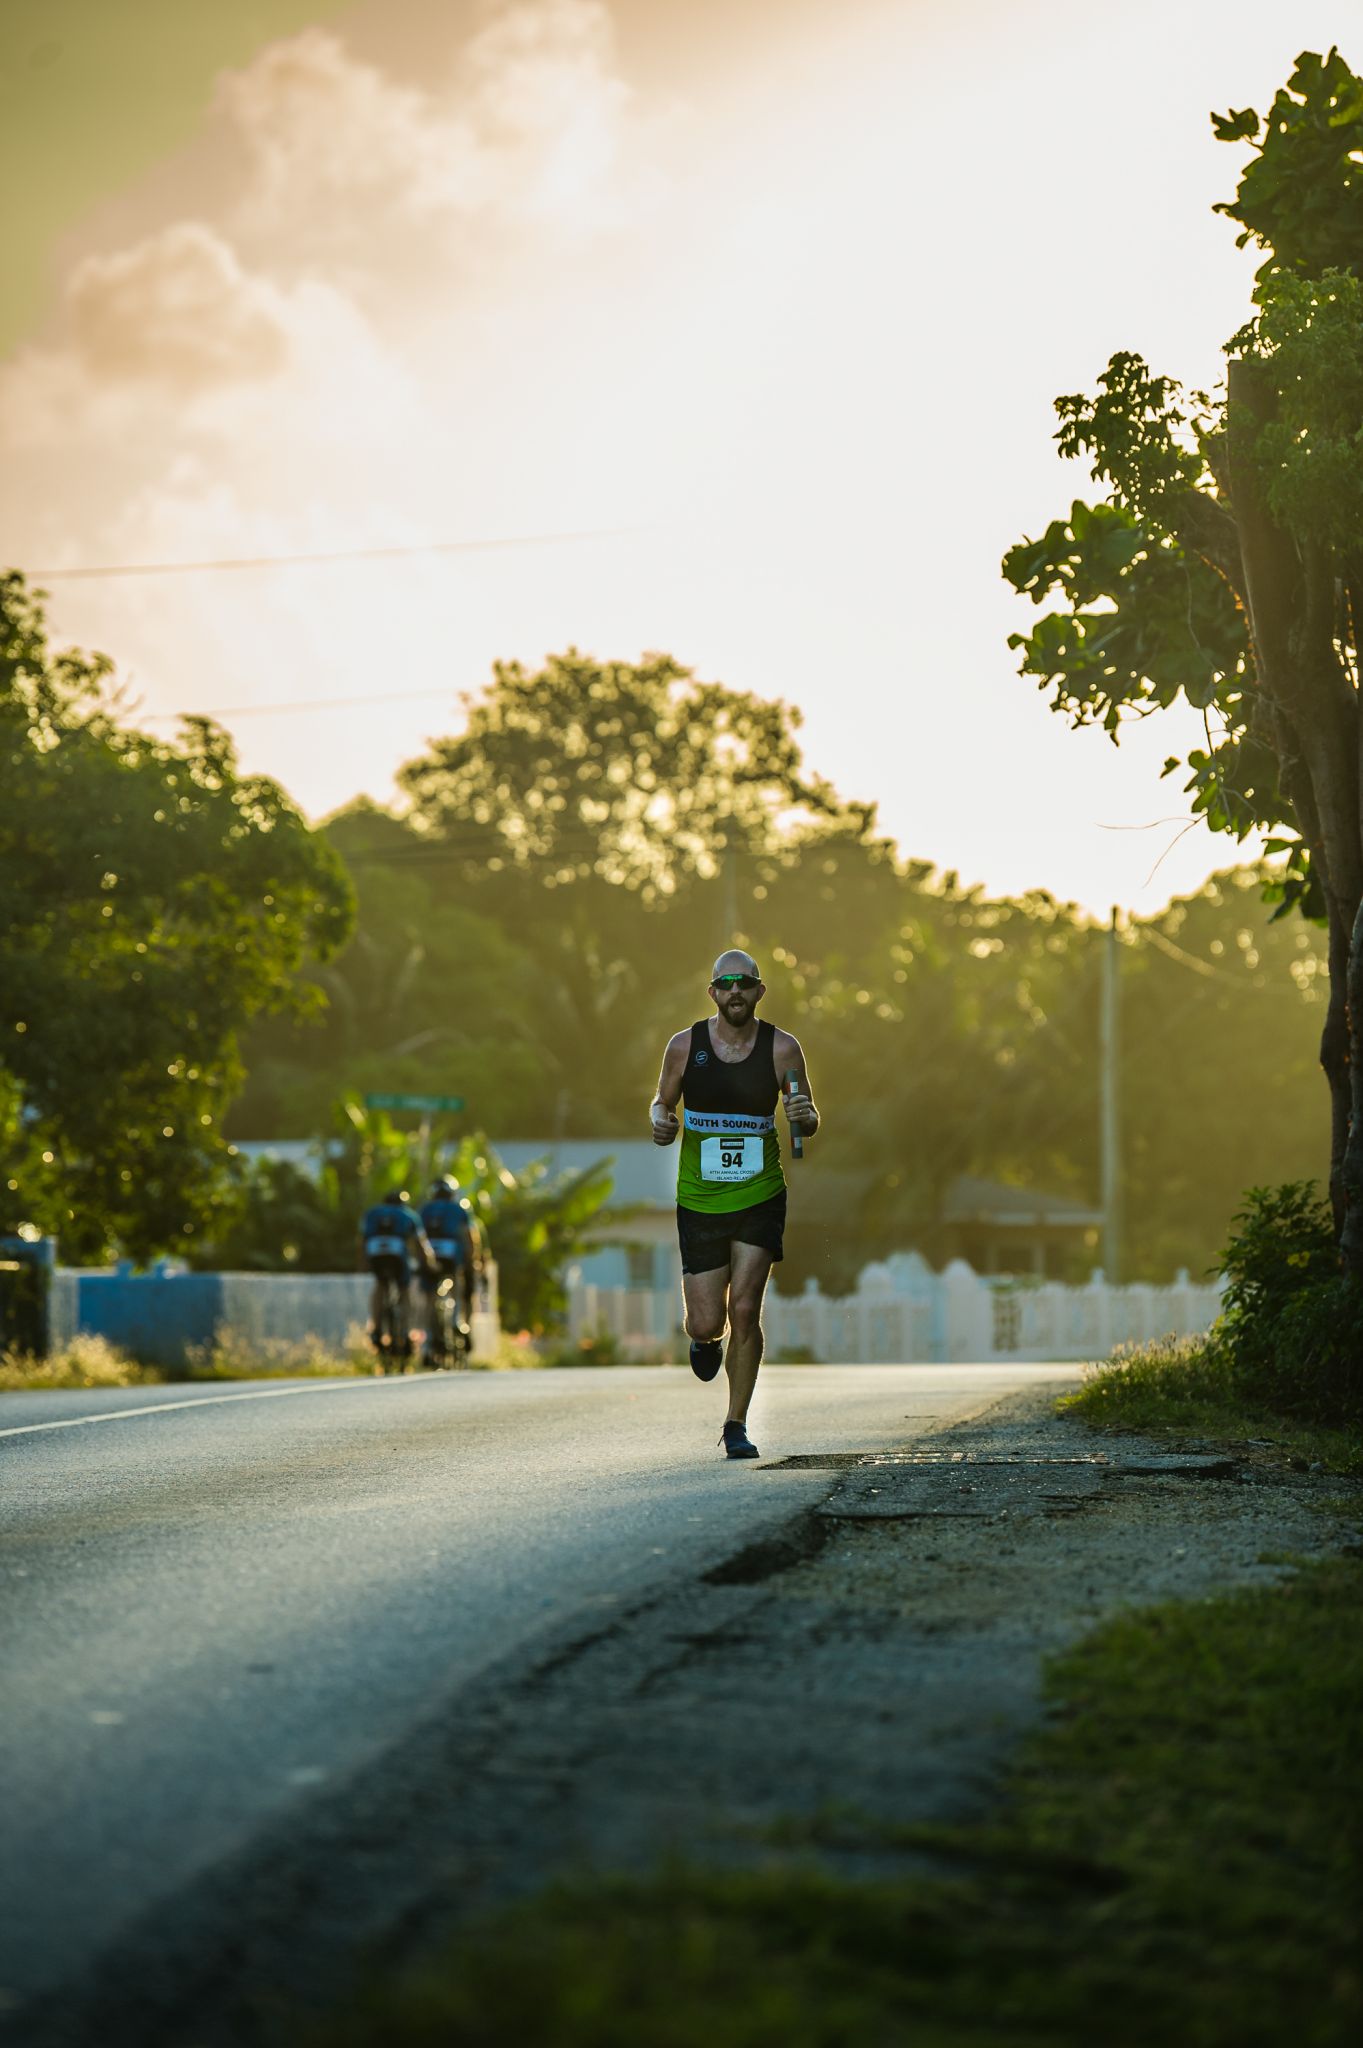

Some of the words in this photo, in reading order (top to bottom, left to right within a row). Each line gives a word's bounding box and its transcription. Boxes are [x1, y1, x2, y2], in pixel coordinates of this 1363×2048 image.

[689, 1117, 719, 1128] SOUTH
[722, 1119, 757, 1130] SOUND
[721, 1152, 743, 1168] 94
